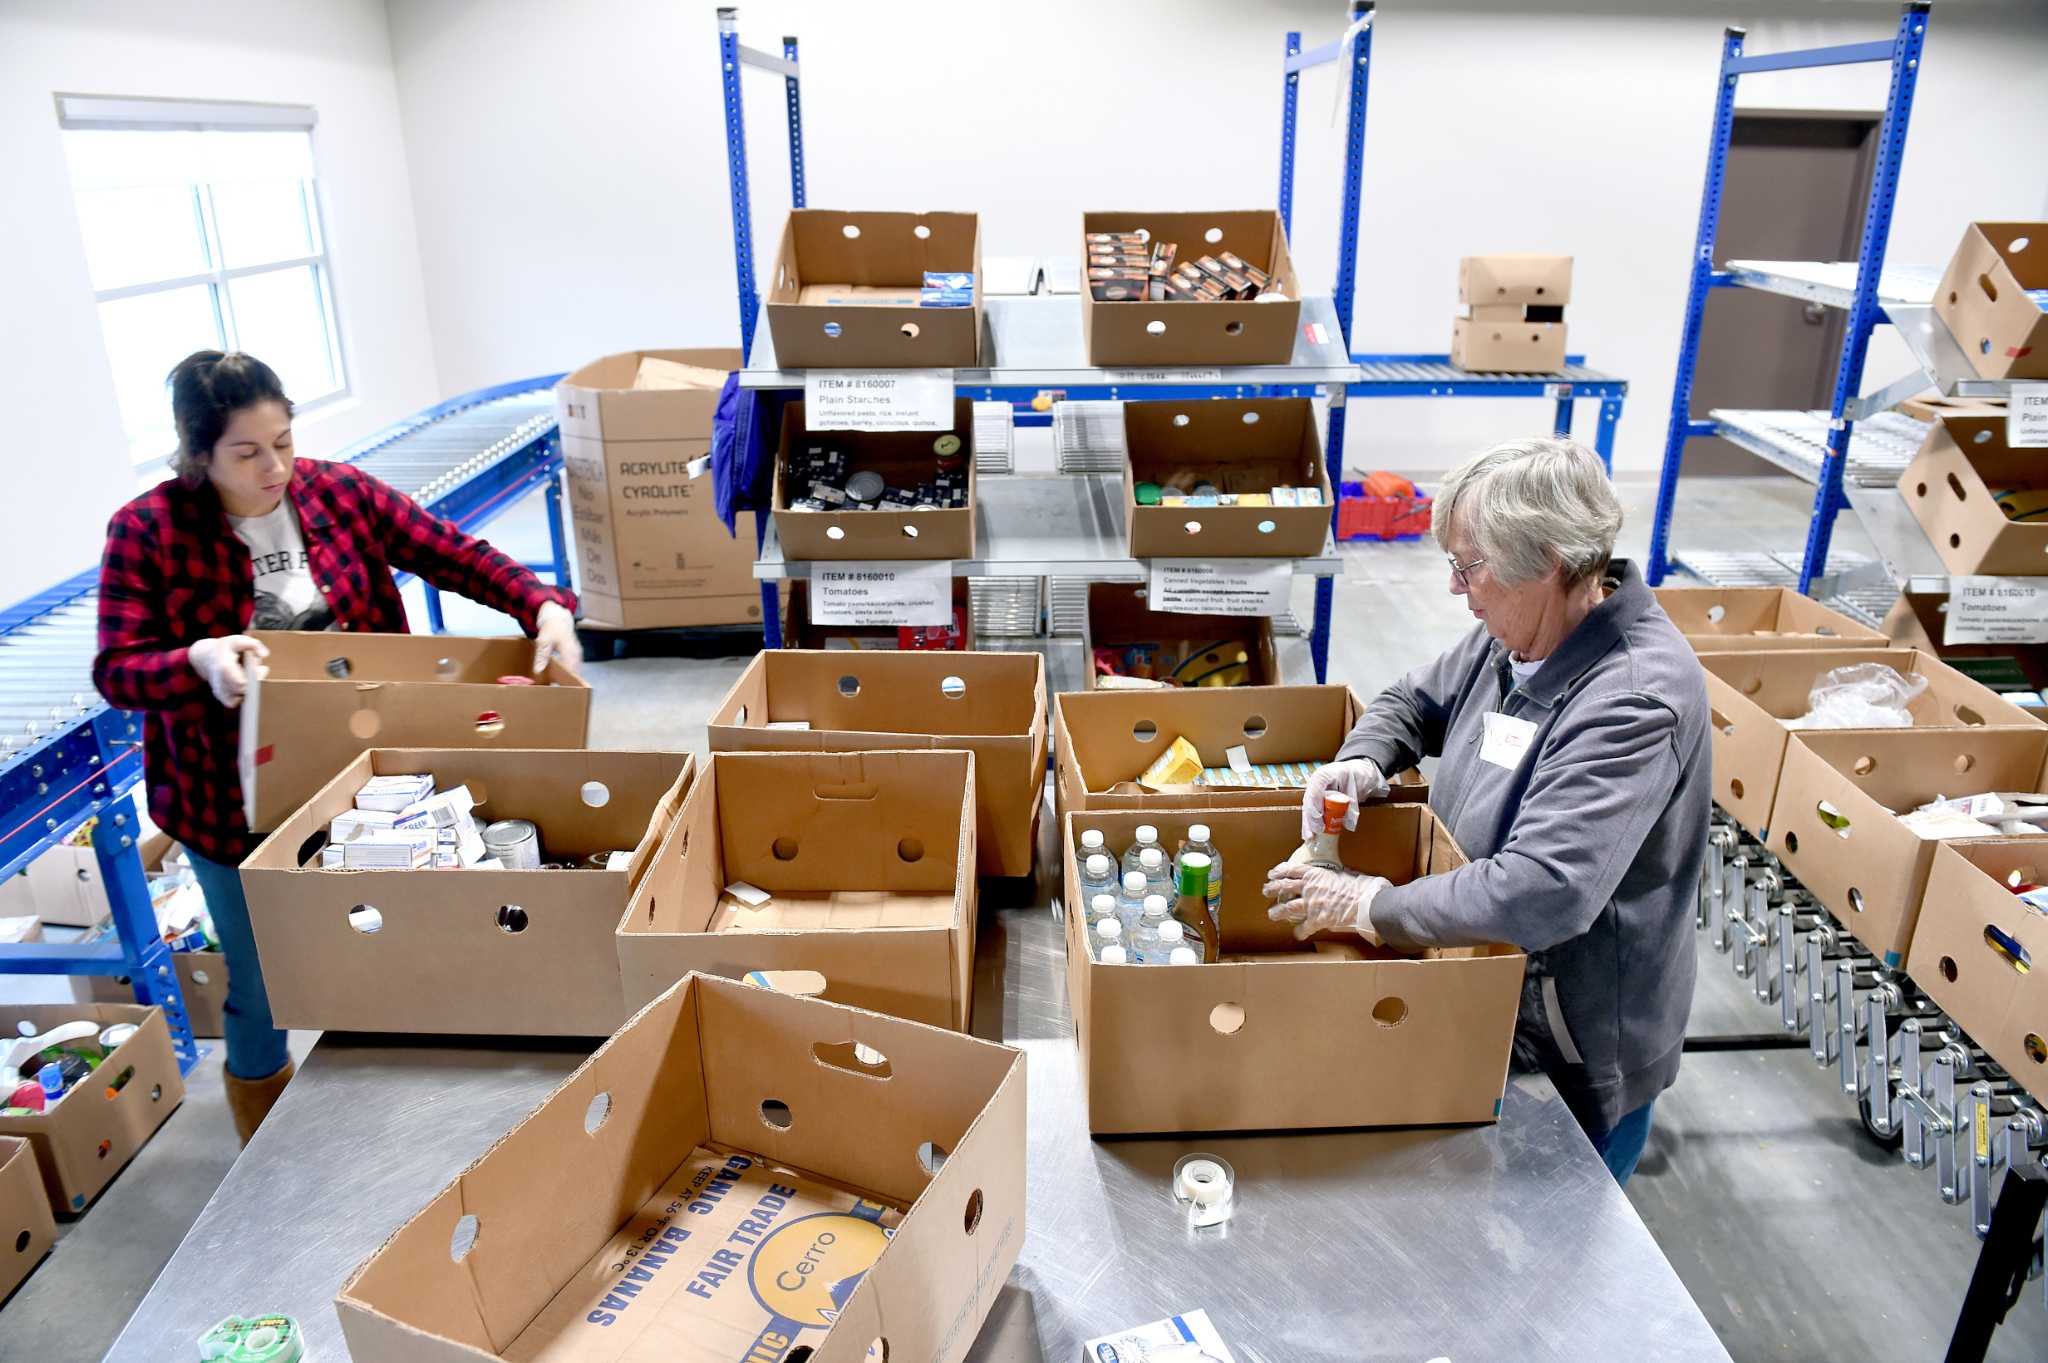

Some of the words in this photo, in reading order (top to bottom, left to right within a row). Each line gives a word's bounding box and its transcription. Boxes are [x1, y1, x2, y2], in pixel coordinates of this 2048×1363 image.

[819, 379, 844, 389] ITEM
[819, 395, 844, 404] Plain
[847, 394, 891, 404] Starches
[620, 461, 688, 475] ACRYLITE
[623, 485, 690, 498] CYROLITE
[251, 551, 292, 576] TER
[822, 572, 845, 581] ITEM
[823, 587, 869, 596] Tomatoes
[1962, 588, 1986, 597] ITEM
[1961, 602, 2007, 611] Tomatoes
[691, 1165, 715, 1188] KEEP
[680, 1188, 693, 1201] AT
[638, 1227, 658, 1243] OR
[685, 1249, 745, 1299] FAIR
[727, 1183, 797, 1246] TRADE
[776, 1232, 836, 1292] Cerro
[586, 1226, 692, 1327] BANANAS
